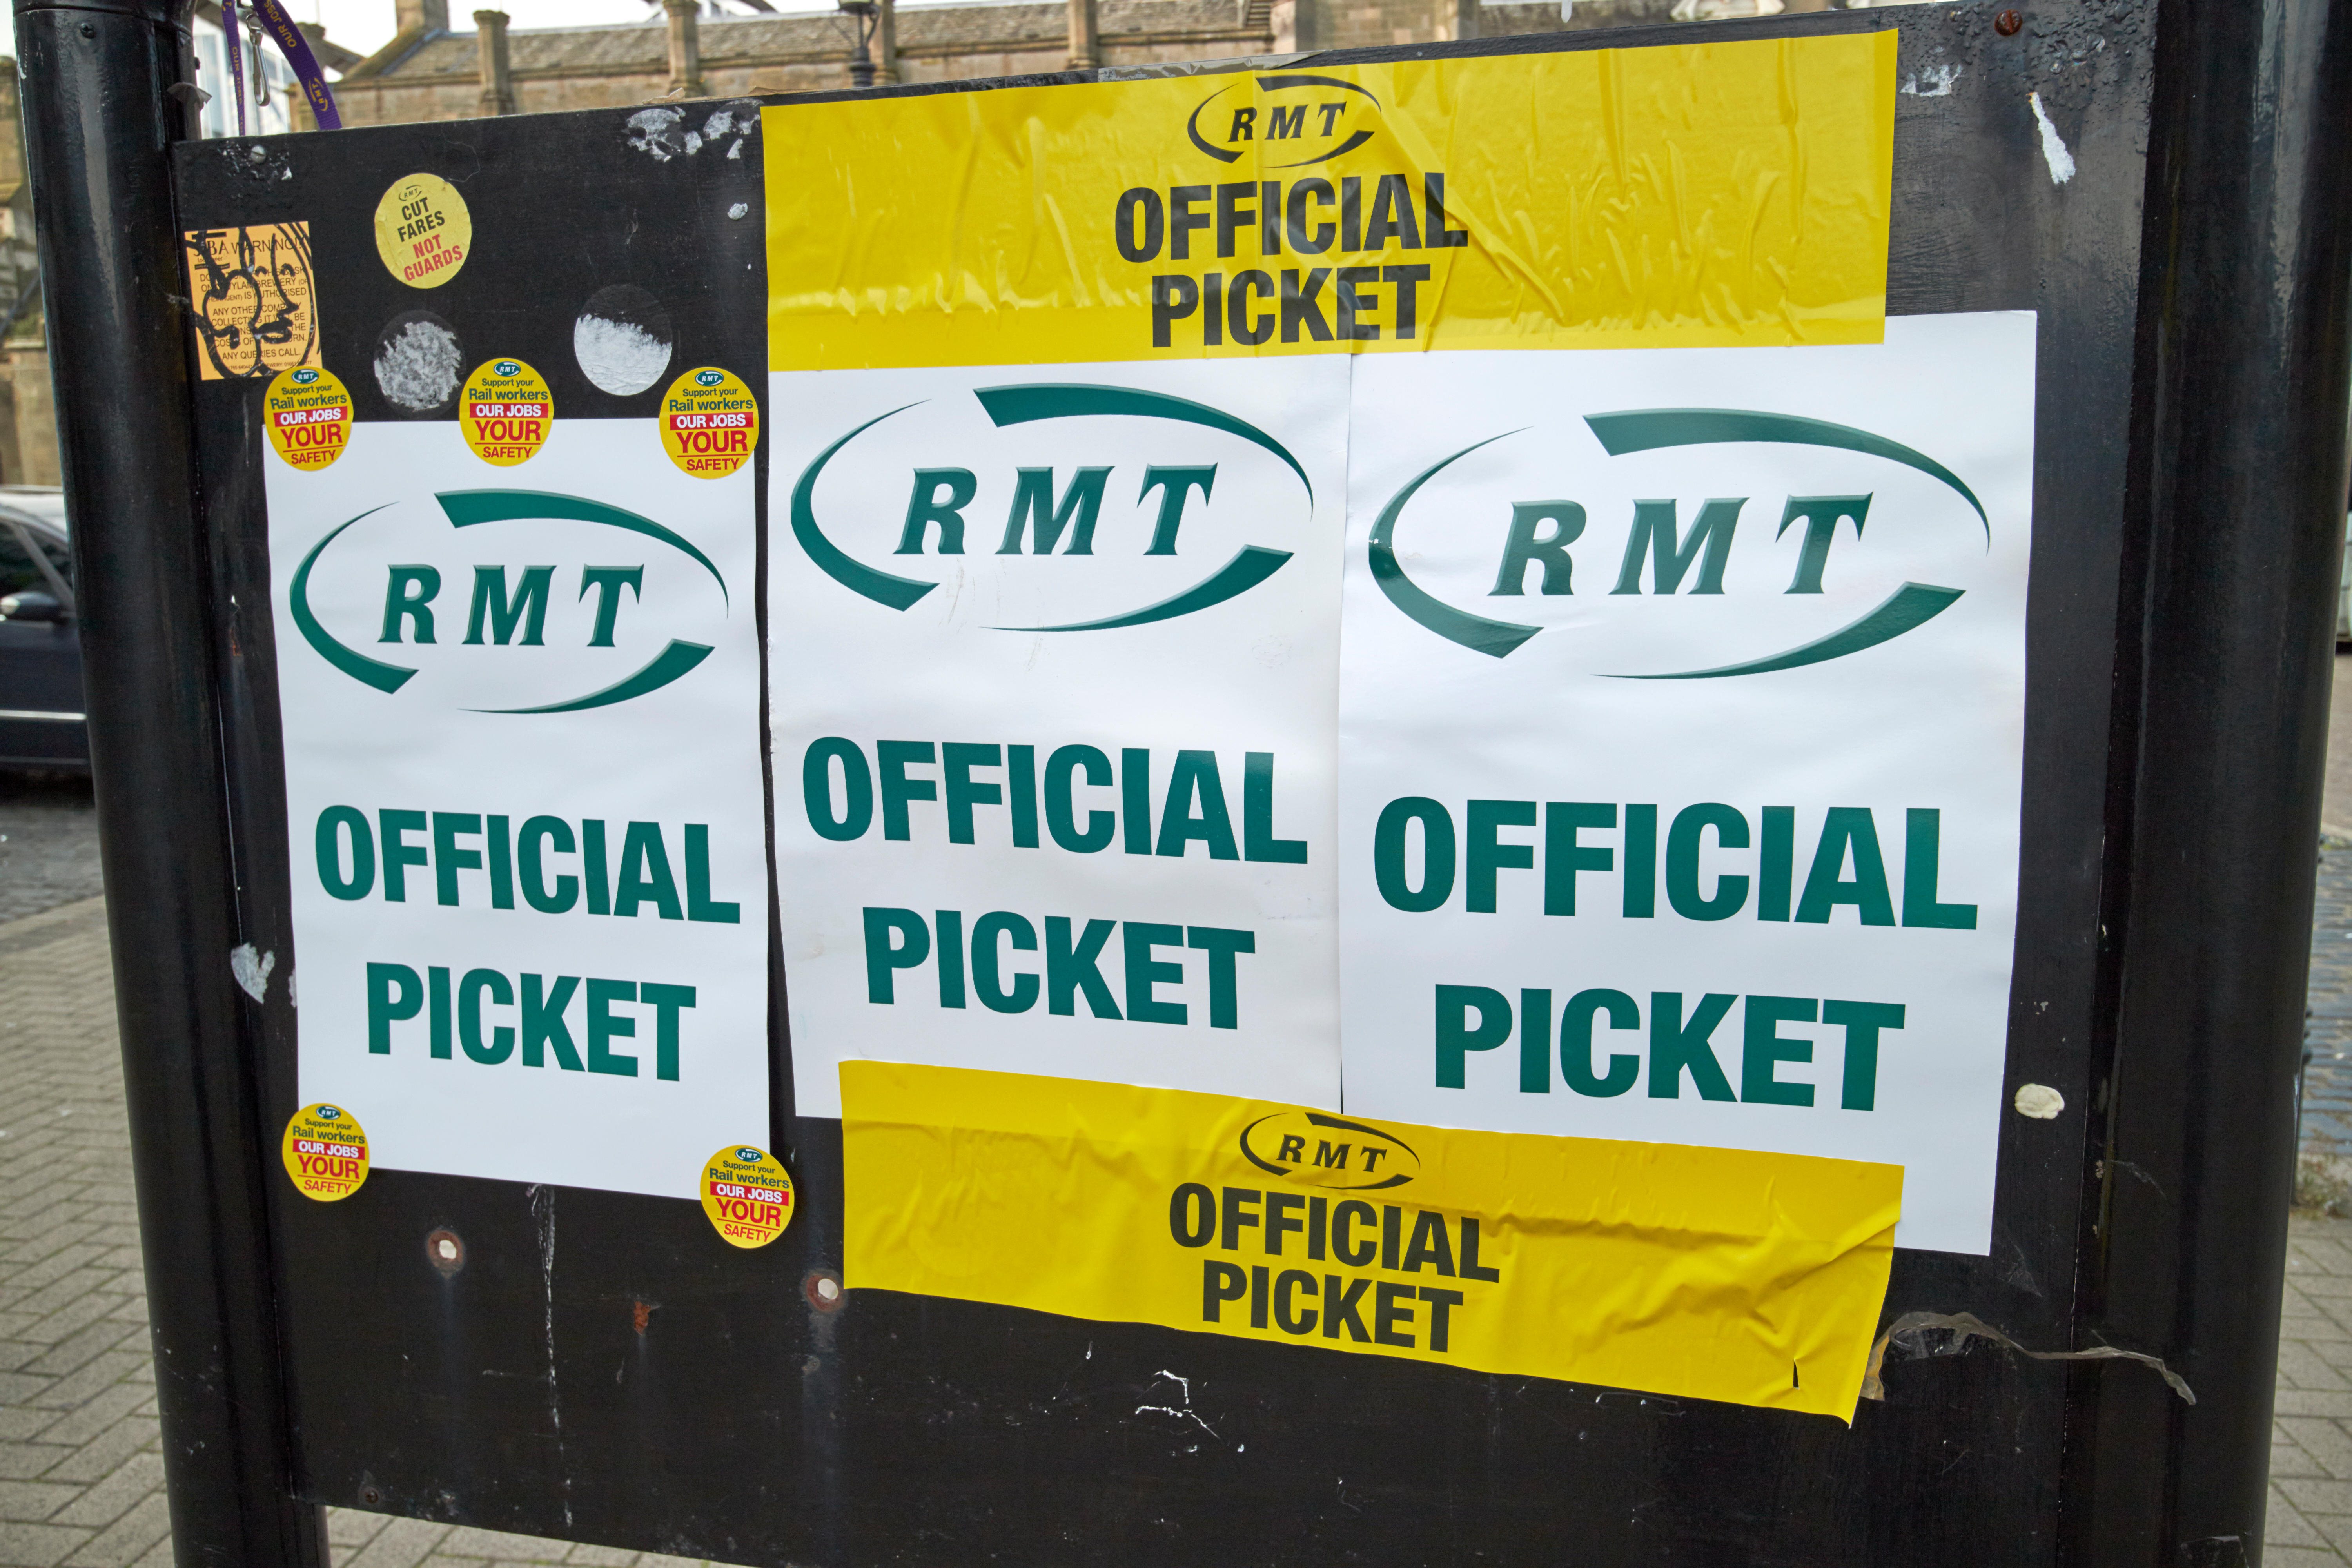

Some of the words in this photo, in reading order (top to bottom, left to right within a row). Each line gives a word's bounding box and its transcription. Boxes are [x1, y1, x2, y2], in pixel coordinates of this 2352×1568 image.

[278, 24, 297, 47] OUR
[312, 83, 325, 104] RMT
[1227, 101, 1347, 142] RMT
[404, 188, 418, 198] RMT
[402, 197, 429, 221] CUT
[1115, 172, 1468, 263] OFFICIAL
[397, 211, 445, 242] FARES
[413, 234, 442, 259] NOT
[404, 245, 463, 281] GUARDS
[256, 277, 296, 287] BREERY
[213, 307, 229, 316] ANY
[1152, 264, 1431, 348] PICKET
[265, 315, 271, 323] IT
[294, 312, 305, 321] BE
[243, 337, 254, 345] OF
[223, 352, 238, 360] ANY
[240, 348, 276, 359] QUEIES
[279, 348, 301, 356] CALL.
[281, 385, 314, 395] Support
[316, 385, 332, 394] your
[482, 378, 514, 387] Support
[683, 388, 717, 398] Support
[719, 389, 738, 397] your
[270, 397, 294, 410] Rail
[297, 394, 347, 407] workers
[469, 388, 492, 400] Rail
[495, 388, 548, 400] workers
[476, 404, 504, 417] OUR
[506, 404, 541, 417] JOBS
[669, 399, 693, 412] Rail
[697, 398, 753, 410] workers
[280, 412, 307, 425] OUR
[309, 408, 341, 423] JOBS
[677, 415, 706, 428] OUR
[710, 414, 746, 427] JOBS
[280, 423, 343, 448] YOUR
[475, 420, 541, 441] YOUR
[483, 446, 532, 458] SAFETY
[676, 430, 748, 453] YOUR
[291, 450, 336, 464] SAFETY
[686, 458, 739, 471] SAFETY
[893, 463, 1218, 556] RMT
[1487, 491, 1874, 596] RMT
[377, 563, 645, 648] RMT
[802, 736, 1308, 864] OFFICIAL
[315, 805, 740, 924] OFFICIAL
[1374, 796, 1978, 930] OFFICIAL
[862, 906, 1255, 1030] PICKET
[367, 962, 697, 1082] PICKET
[1435, 984, 1906, 1112] PICKET
[305, 1118, 334, 1128] Support
[293, 1126, 314, 1138] Rail
[317, 1131, 365, 1144] workers
[299, 1141, 325, 1154] OUR
[327, 1144, 359, 1158] JOBS
[1276, 1134, 1387, 1173] RMT
[297, 1154, 360, 1179] YOUR
[723, 1160, 755, 1171] Support
[304, 1180, 352, 1194] SAFETY
[710, 1168, 733, 1181] Rail
[736, 1173, 789, 1189] workers
[716, 1184, 745, 1198] OUR
[748, 1188, 782, 1203] JOBS
[715, 1198, 781, 1227] YOUR
[724, 1223, 771, 1242] SAFETY
[1169, 1182, 1500, 1284] OFFICIAL
[1203, 1259, 1464, 1353] PICKET
